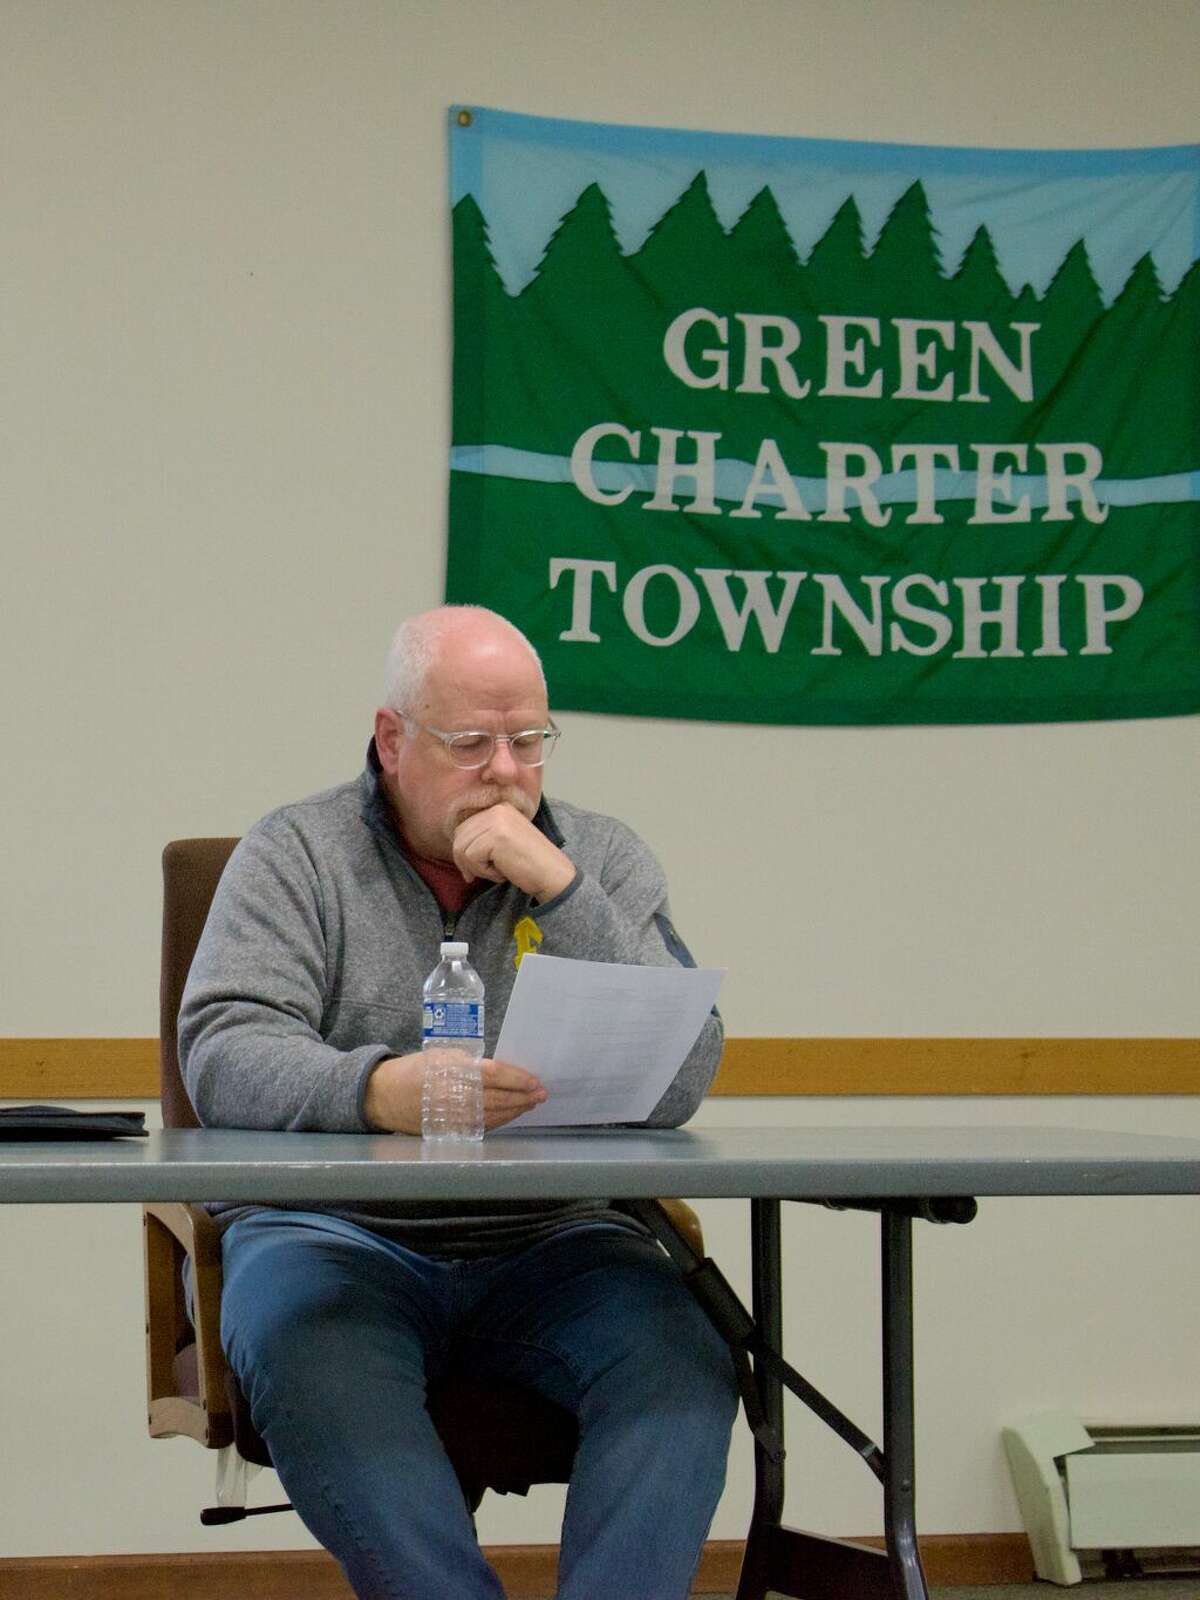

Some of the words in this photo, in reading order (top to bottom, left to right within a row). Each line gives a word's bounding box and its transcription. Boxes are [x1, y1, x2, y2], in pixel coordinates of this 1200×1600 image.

[663, 307, 1040, 403] GREEN
[569, 422, 1108, 527] CHARTER
[549, 557, 1145, 659] TOWNSHIP
